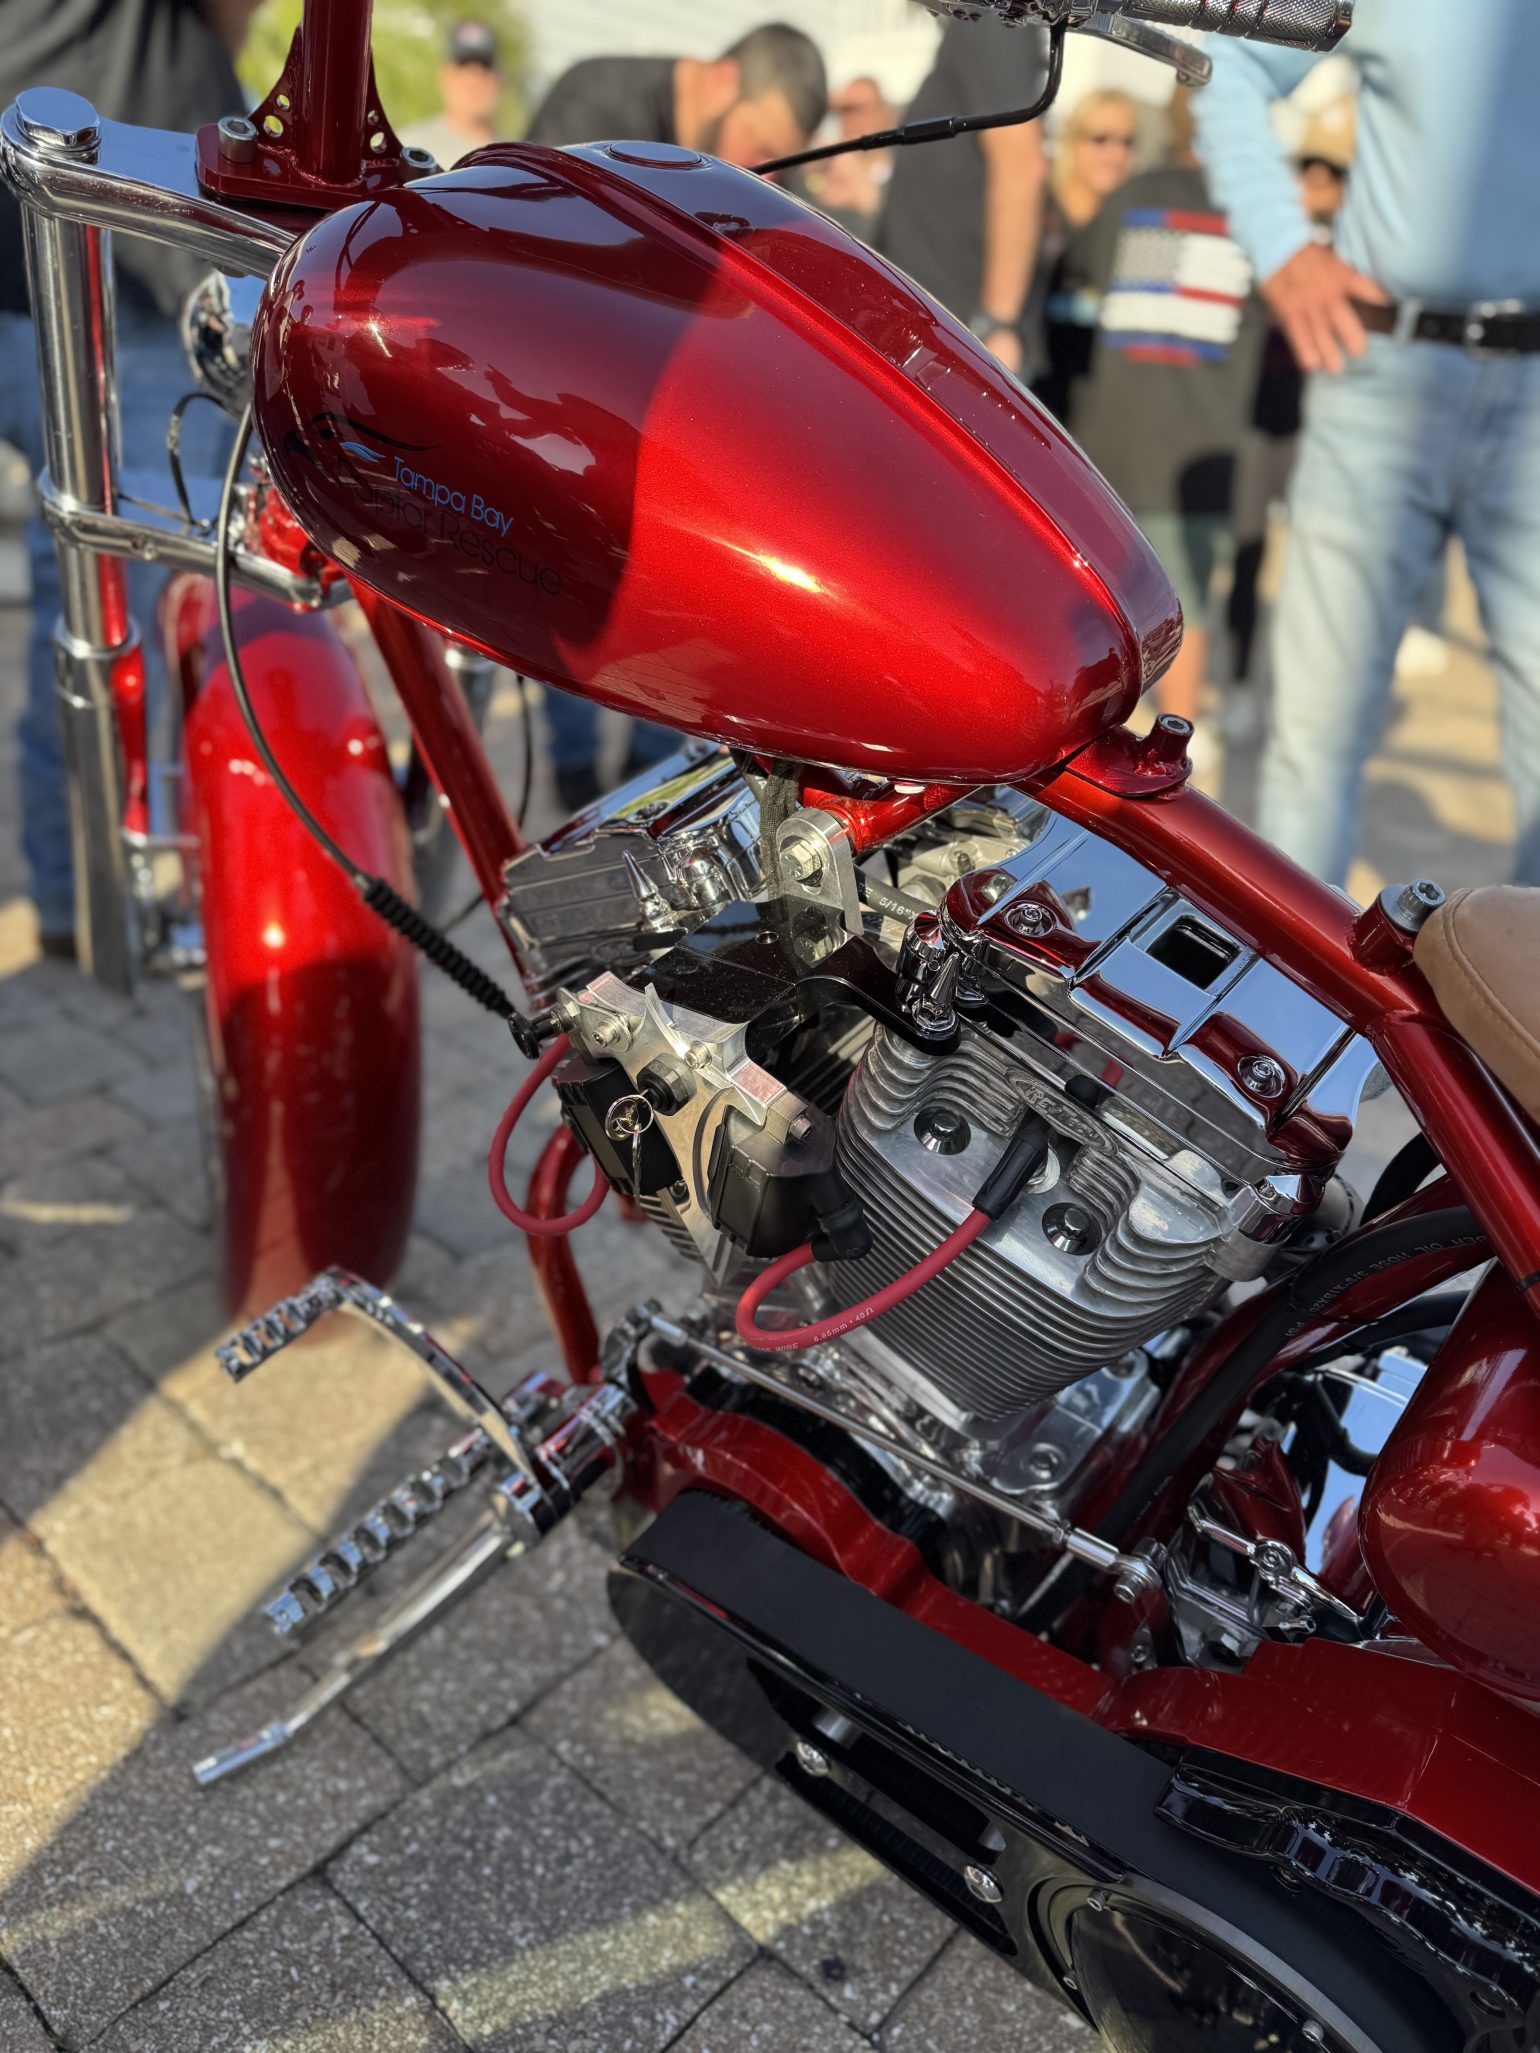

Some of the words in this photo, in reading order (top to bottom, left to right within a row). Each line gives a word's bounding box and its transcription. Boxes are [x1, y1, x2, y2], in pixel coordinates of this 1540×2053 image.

[394, 456, 467, 515] Tampa
[470, 494, 514, 538] Bay
[438, 511, 563, 595] Rescue
